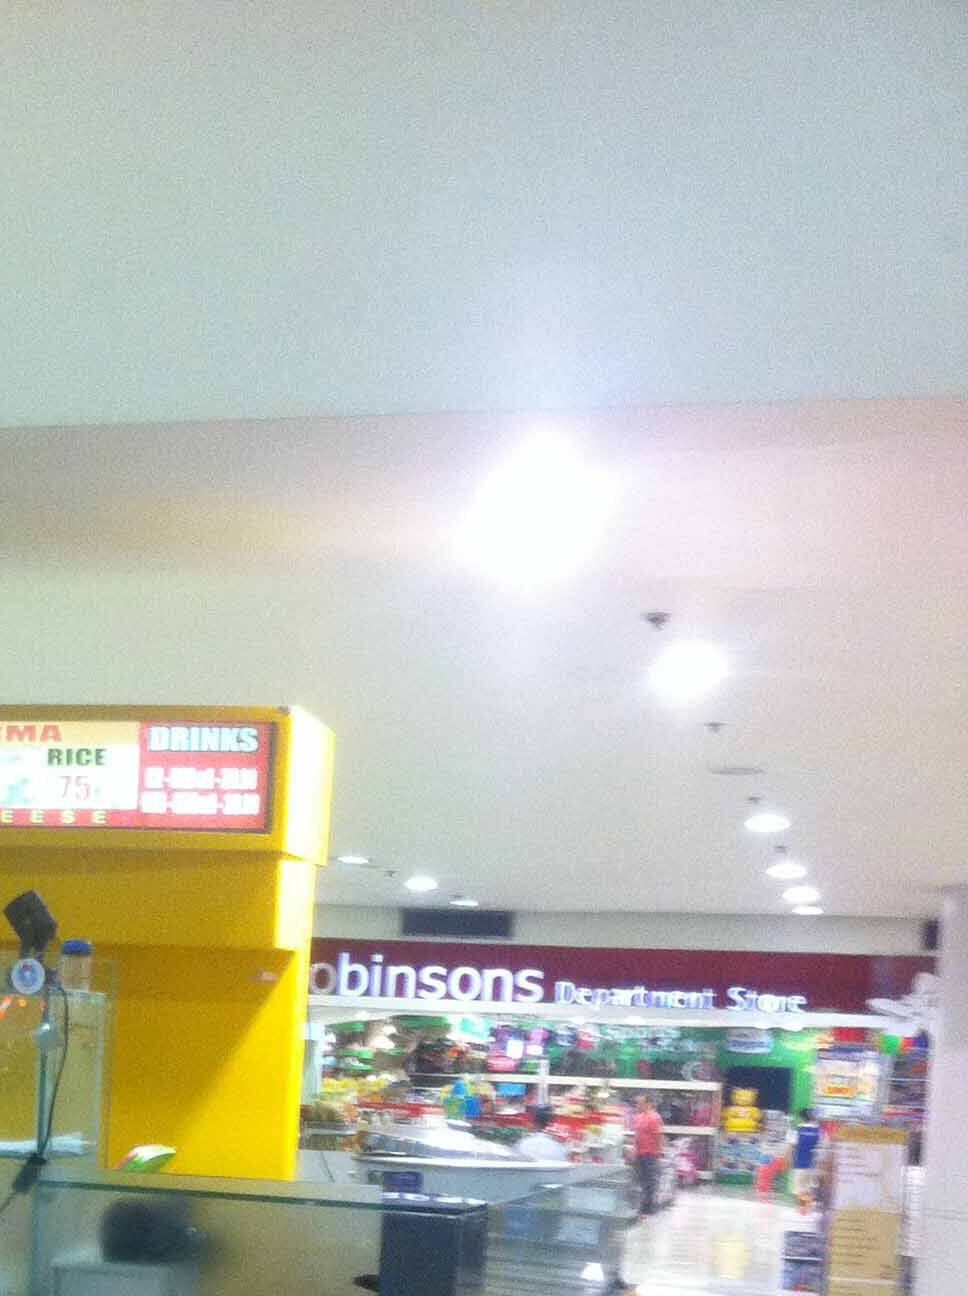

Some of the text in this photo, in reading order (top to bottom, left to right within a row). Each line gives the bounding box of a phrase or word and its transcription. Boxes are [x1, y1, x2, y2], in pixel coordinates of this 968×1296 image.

[148, 727, 259, 752] DRINKS
[48, 748, 106, 767] RICE
[61, 775, 91, 800] 75
